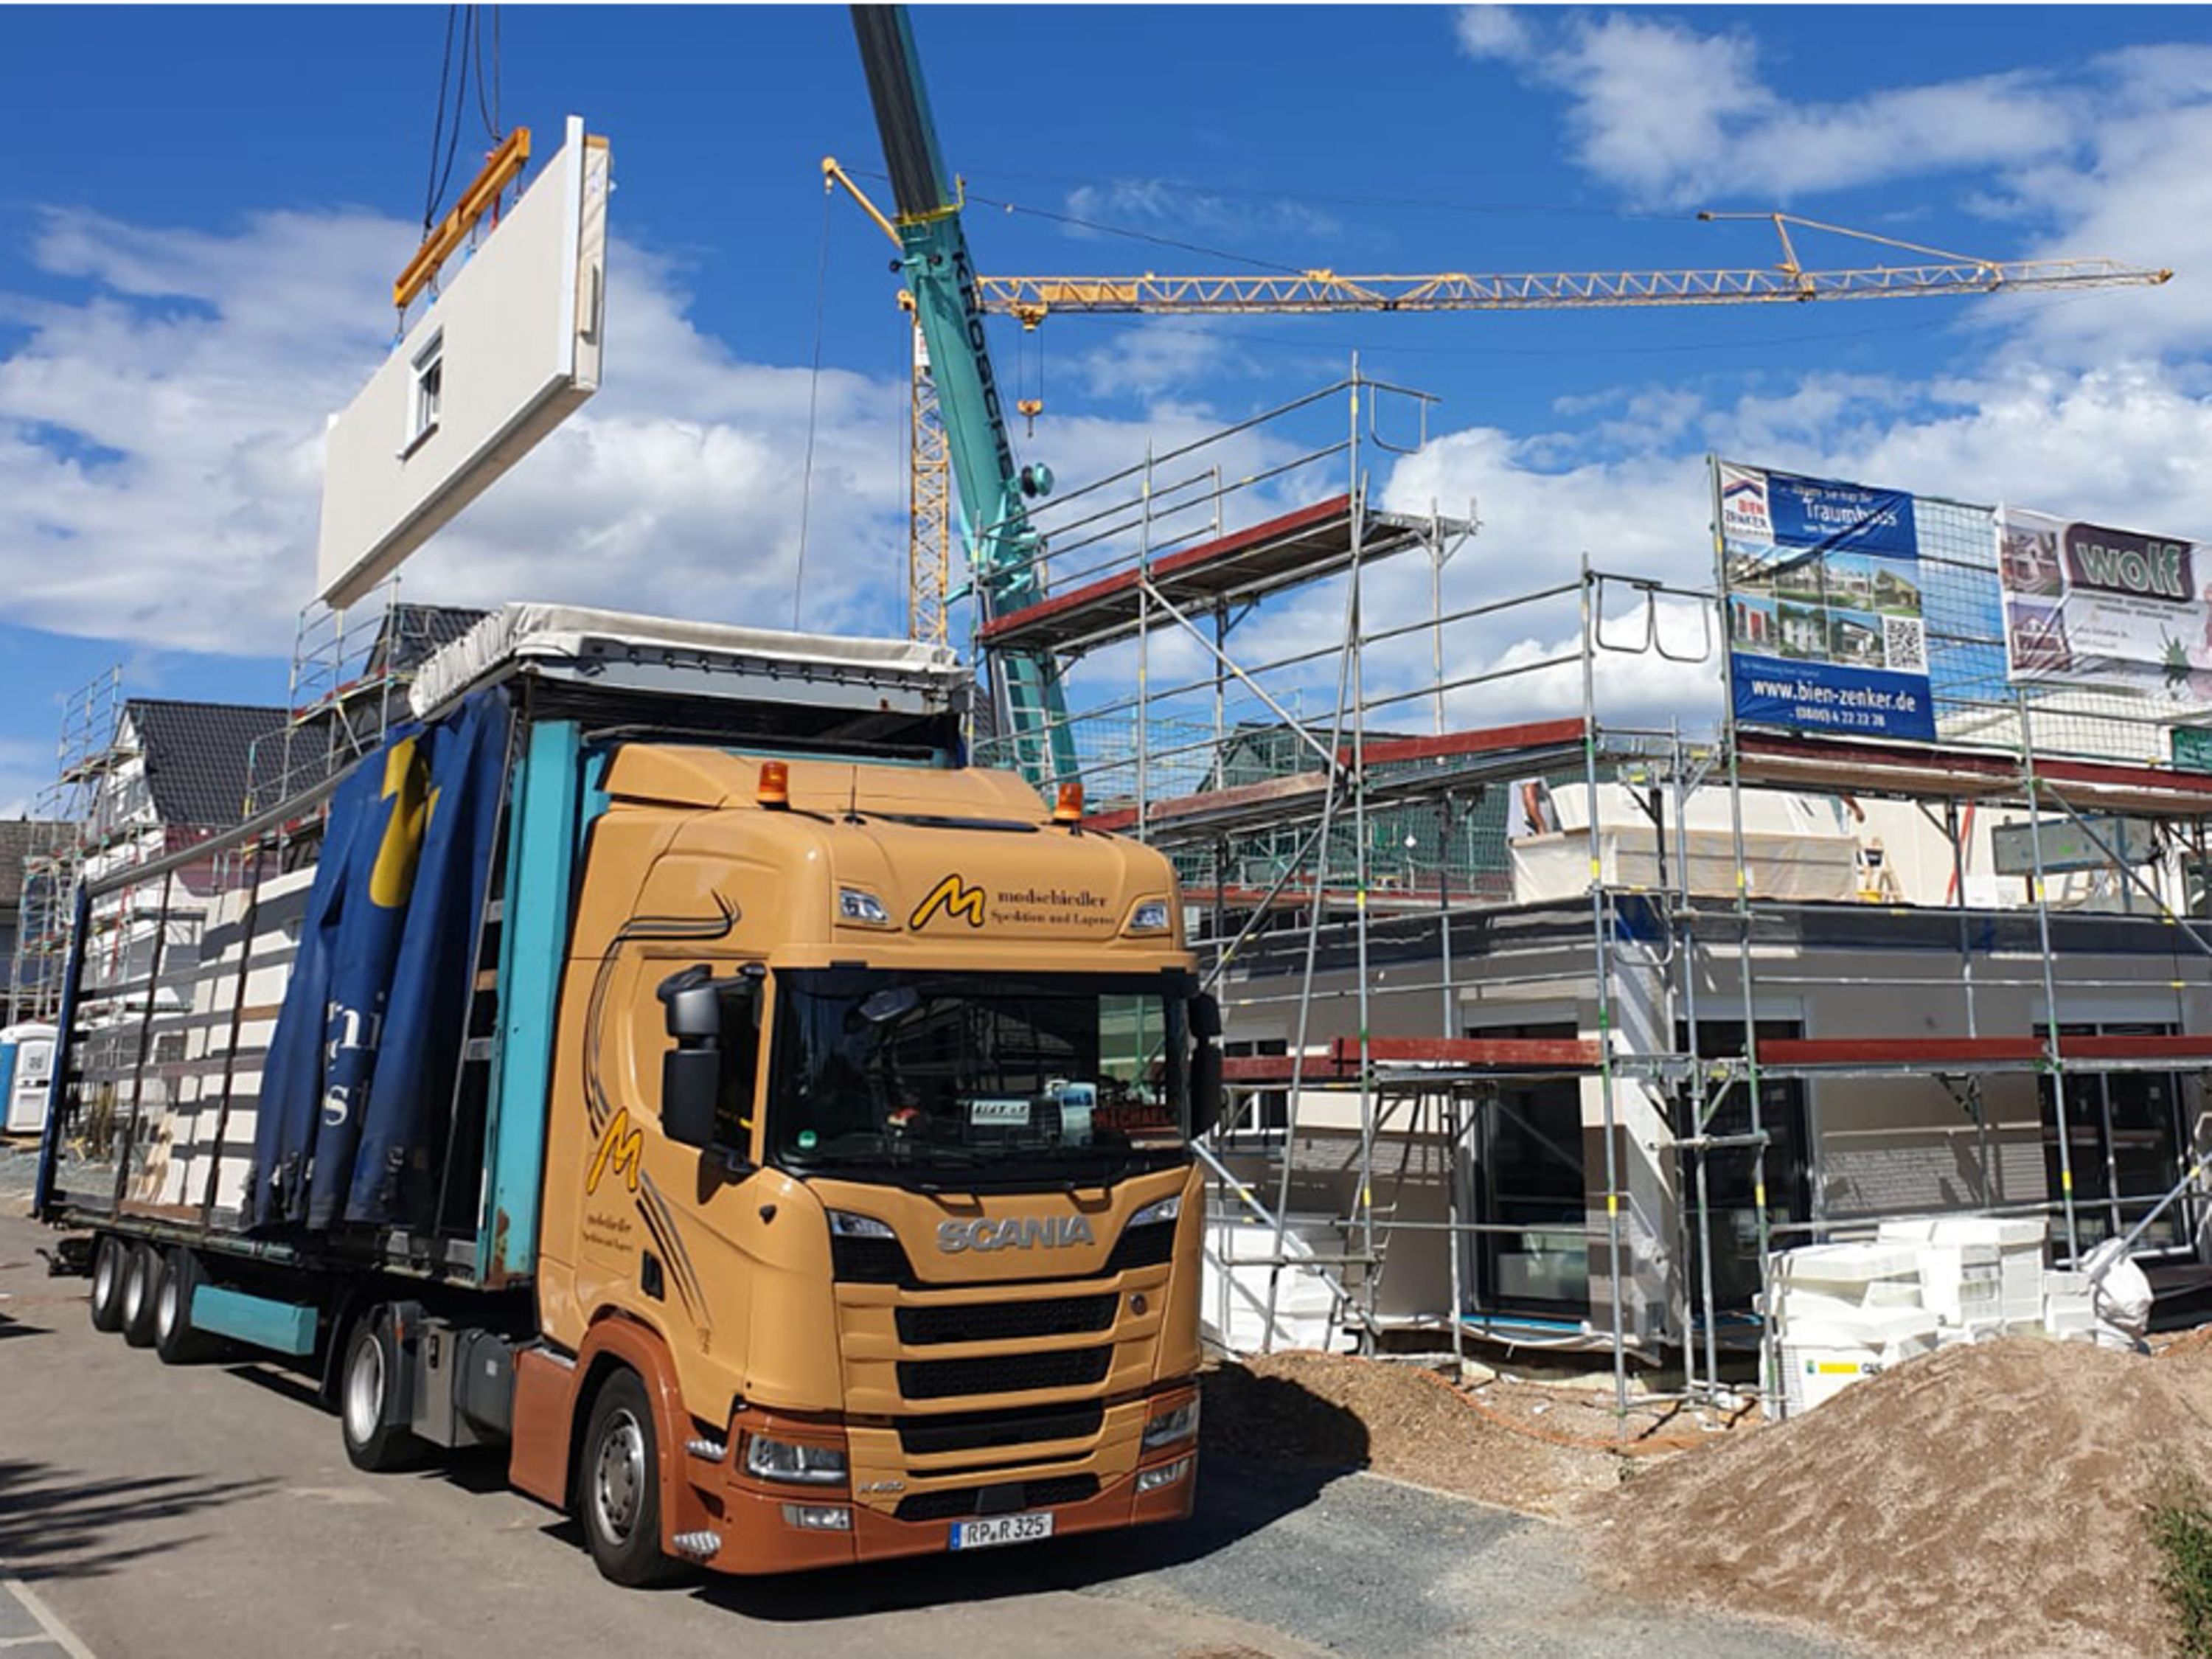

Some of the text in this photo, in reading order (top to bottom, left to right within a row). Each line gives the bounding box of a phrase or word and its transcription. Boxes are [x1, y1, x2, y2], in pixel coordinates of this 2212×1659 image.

[2075, 541, 2185, 597] wolf
[1751, 679, 1916, 712] www.bien-zenker.de
[936, 1214, 1096, 1253] SCANIA
[1000, 1520, 1010, 1540] R
[1014, 1516, 1045, 1538] 325
